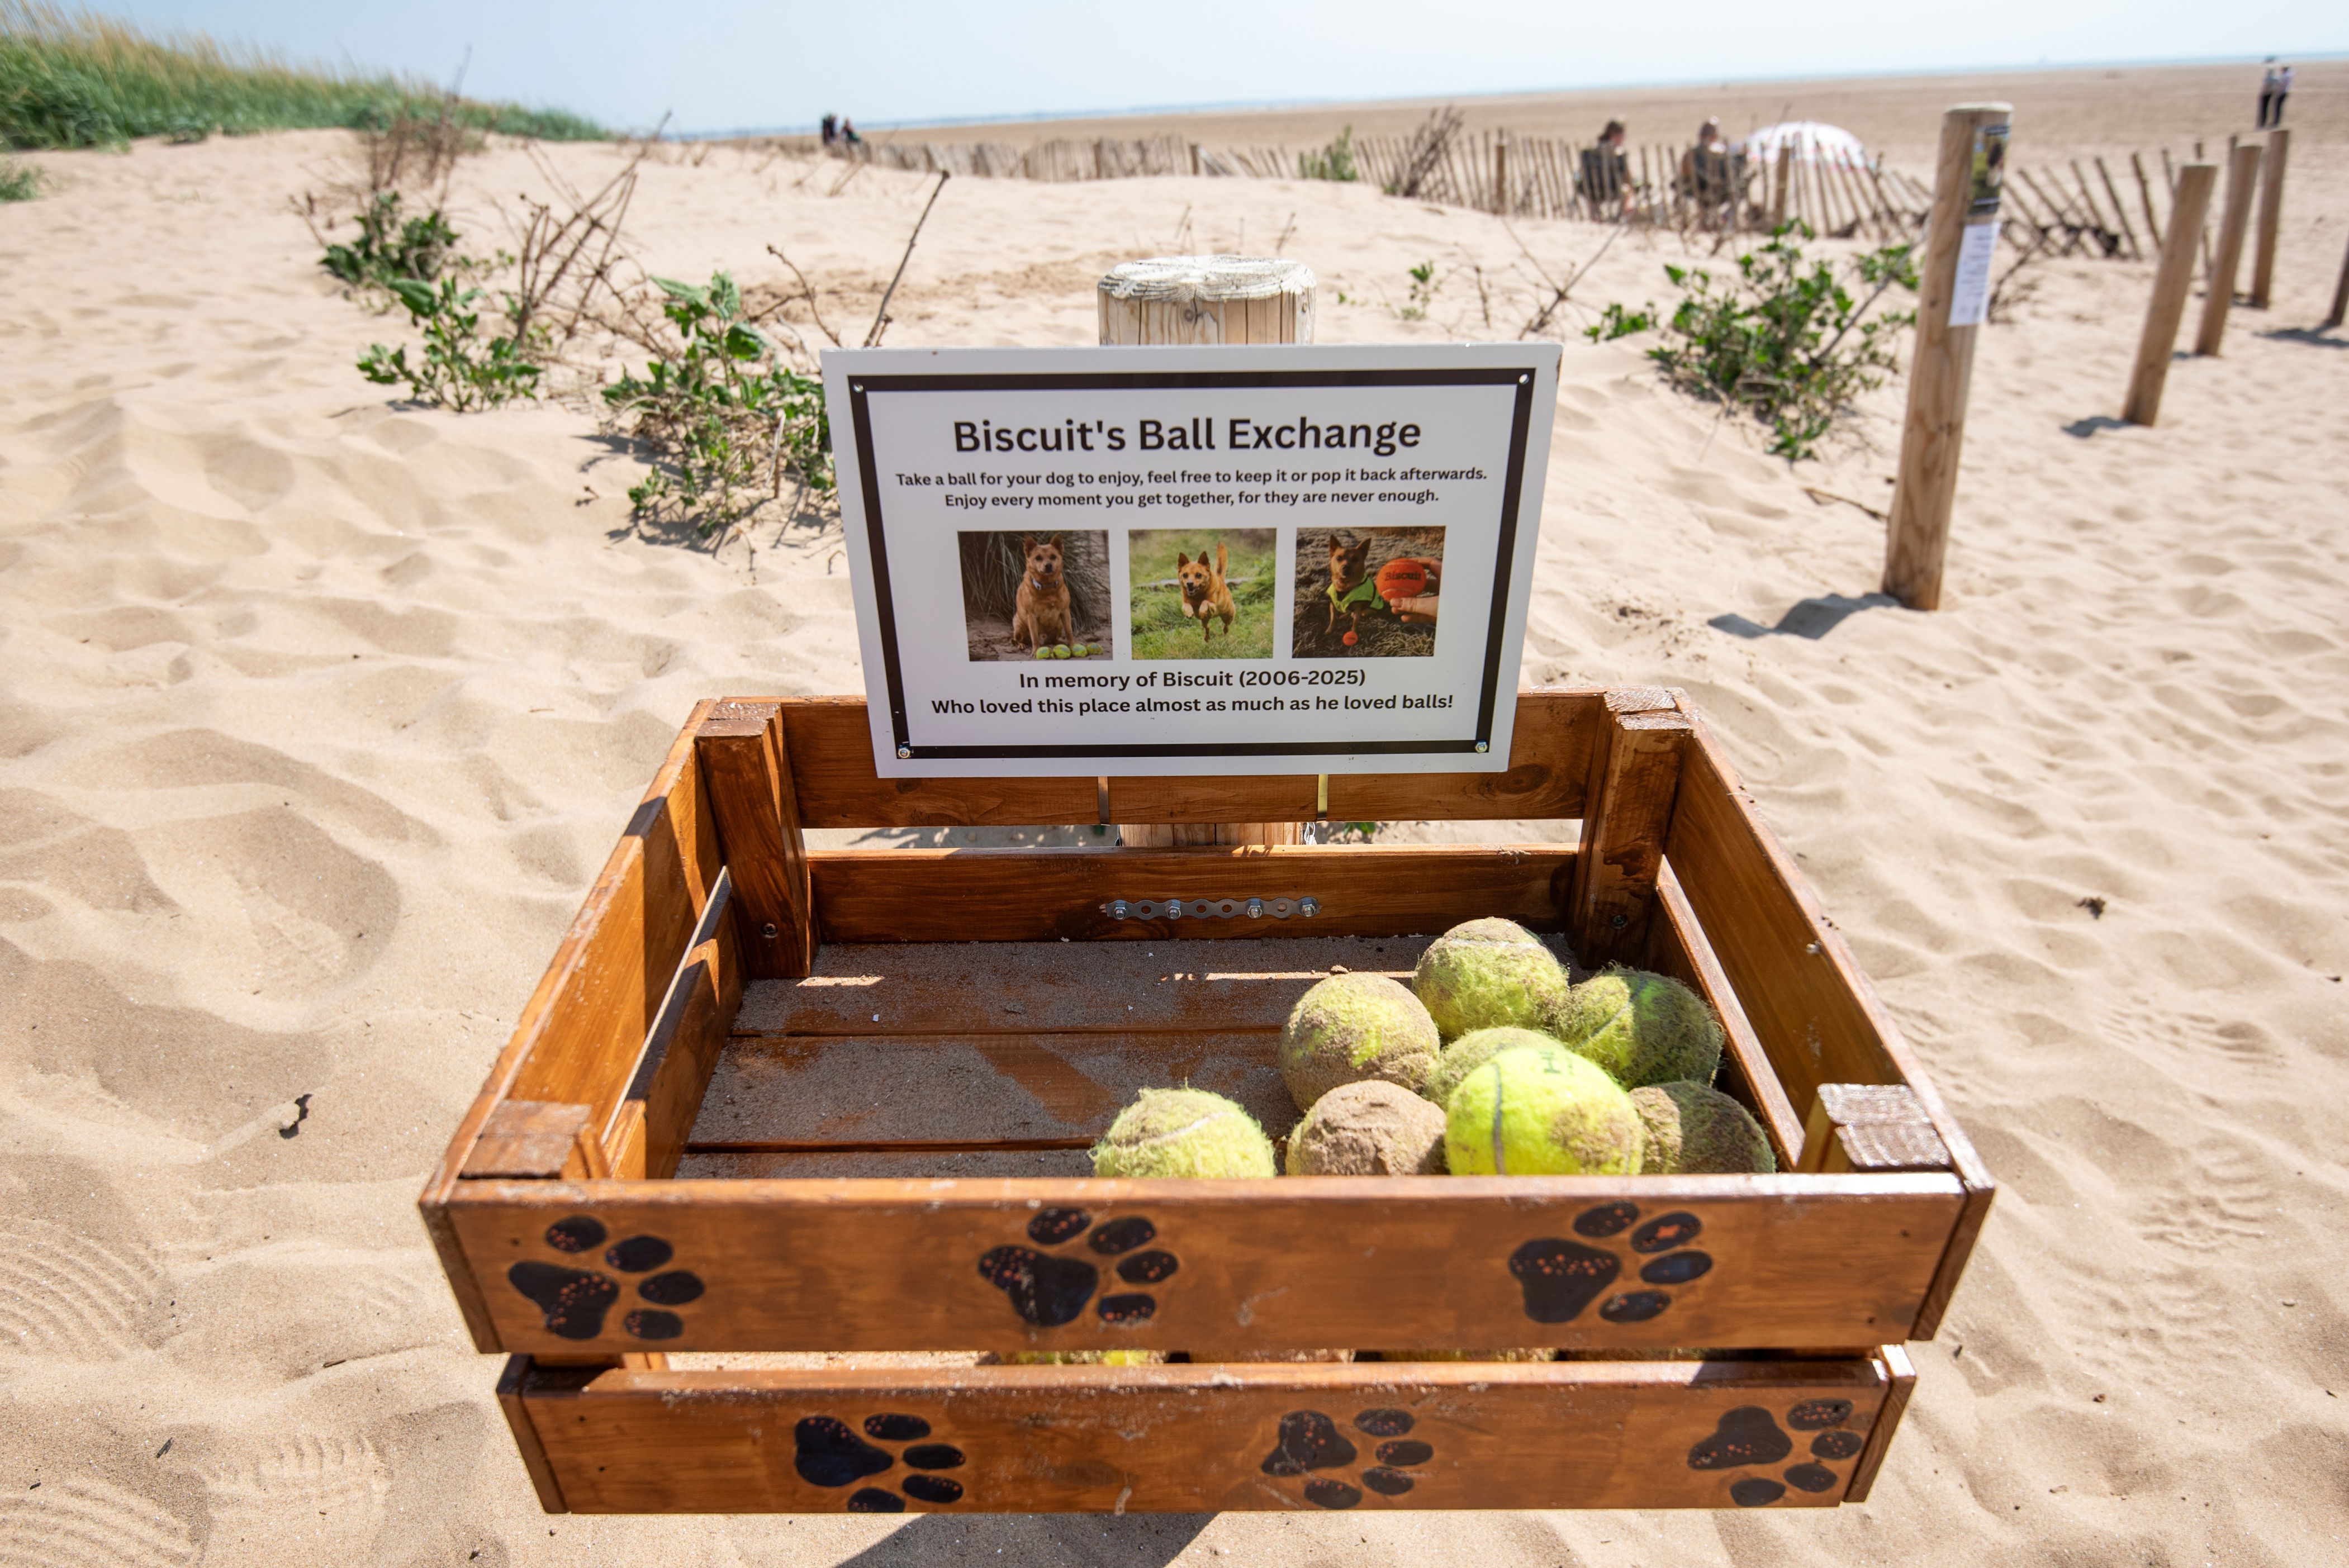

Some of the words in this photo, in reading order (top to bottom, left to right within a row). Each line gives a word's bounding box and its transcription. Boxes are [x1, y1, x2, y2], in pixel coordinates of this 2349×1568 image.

[953, 418, 1126, 452] Biscuit's
[1139, 417, 1216, 450] Ball
[1228, 416, 1421, 457] Exchange
[895, 472, 932, 485] Take
[935, 476, 945, 484] a
[947, 472, 977, 484] ball
[980, 472, 1003, 484] for
[1006, 474, 1042, 487] your
[1045, 471, 1075, 487] dog
[1078, 472, 1094, 483] to
[1098, 471, 1144, 486] enjoy,
[1147, 470, 1177, 483] feel
[1180, 469, 1212, 482] free
[1214, 471, 1232, 482] to
[1235, 469, 1273, 484] keep
[1276, 469, 1287, 481] it
[1290, 472, 1308, 481] or
[1311, 471, 1341, 484] pop
[1345, 468, 1356, 481] it
[1360, 467, 1397, 480] back
[1399, 466, 1487, 479] afterwards.
[945, 493, 988, 509] Enjoy
[991, 496, 1034, 509] every
[1038, 493, 1103, 505] moment
[1105, 495, 1134, 507] you
[1137, 493, 1162, 507] get
[1165, 491, 1235, 507] together,
[1238, 490, 1261, 503] for
[1264, 490, 1299, 506] they
[1302, 493, 1327, 502] are
[1331, 492, 1375, 502] never
[1378, 488, 1439, 504] enough.
[1019, 673, 1039, 687] In
[1045, 676, 1131, 691] memory
[1136, 671, 1158, 686] of
[1163, 671, 1233, 686] Biscuit
[1239, 669, 1365, 687] (2006-2025)
[931, 699, 975, 713] Who
[979, 699, 1033, 712] loved
[1037, 698, 1074, 712] this
[1079, 698, 1131, 715] place
[1135, 697, 1202, 711] almost
[1206, 700, 1227, 710] as
[1232, 696, 1284, 710] much
[1289, 699, 1311, 710] as
[1316, 695, 1339, 709] he
[1344, 695, 1397, 709] loved
[1402, 694, 1453, 708] balls!
